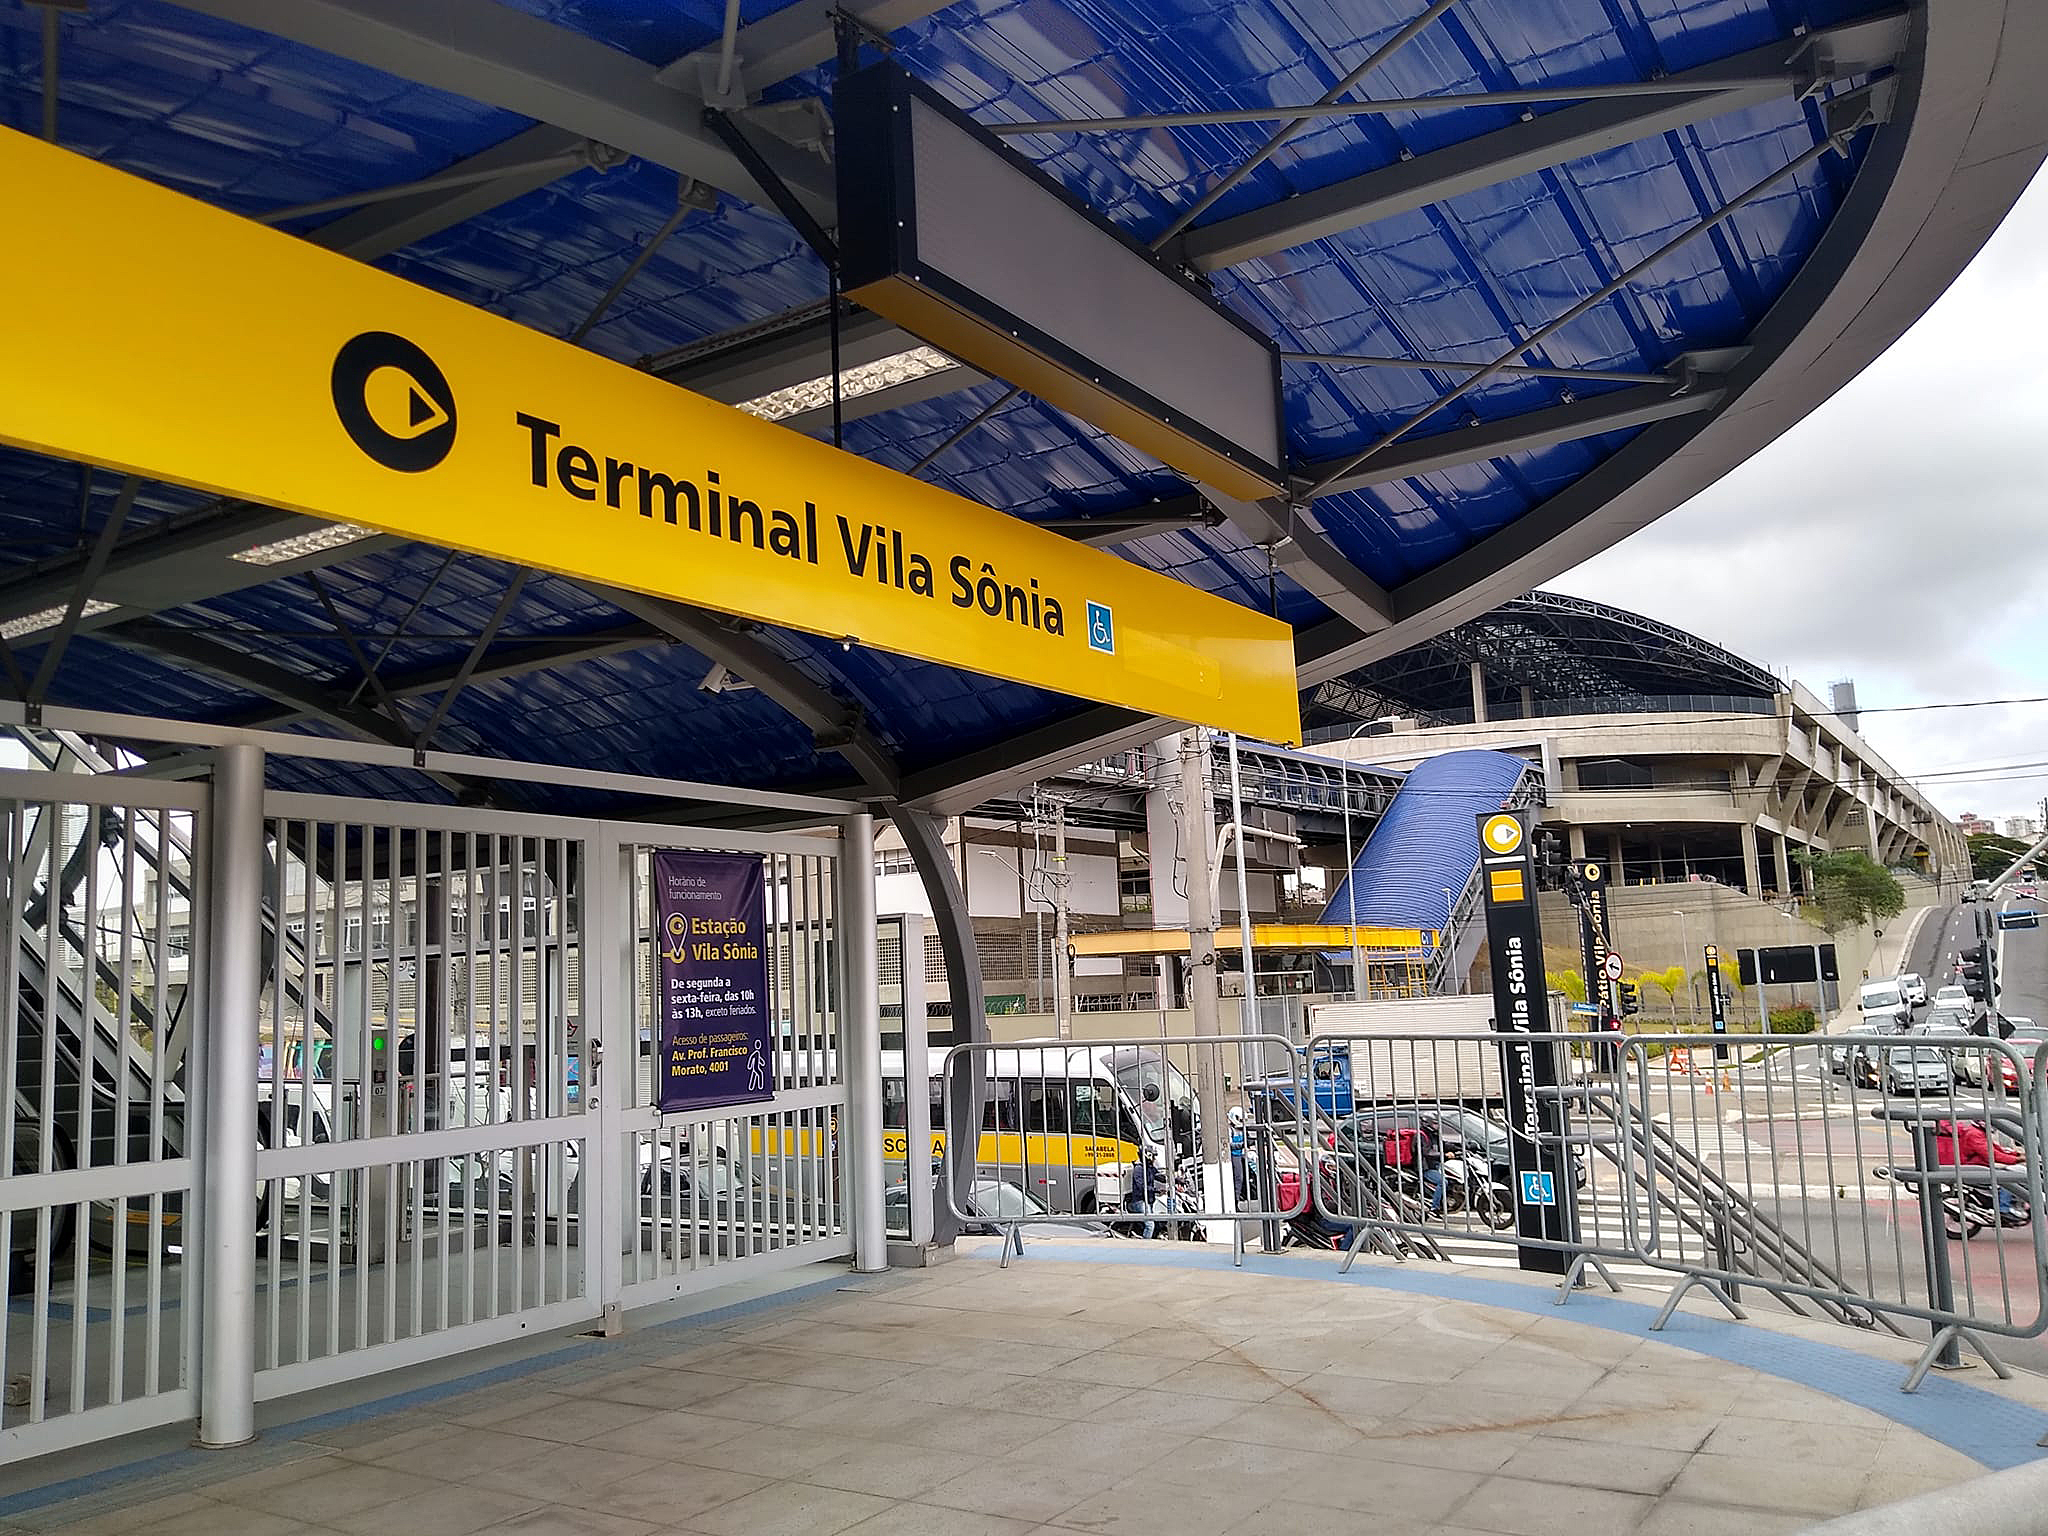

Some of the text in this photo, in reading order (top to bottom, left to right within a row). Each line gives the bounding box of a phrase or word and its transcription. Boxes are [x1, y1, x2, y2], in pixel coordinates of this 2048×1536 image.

[516, 412, 1064, 637] Terminal Vila Sônia
[668, 875, 706, 887] Horário de
[669, 888, 722, 900] funcionamento
[691, 917, 747, 939] Estação
[691, 942, 758, 961] Vila Sônia
[1505, 936, 1527, 994] Sônia
[671, 976, 732, 991] De segunda a
[671, 989, 755, 1005] sexta-feira, das 10h
[671, 1004, 757, 1019] às 13h, exceto feriados.
[672, 1031, 749, 1046] Acesso de passageiros:
[671, 1045, 748, 1061] Av. Prof. Francisco
[671, 1060, 729, 1077] Morato, 4001
[375, 1087, 384, 1095] 07
